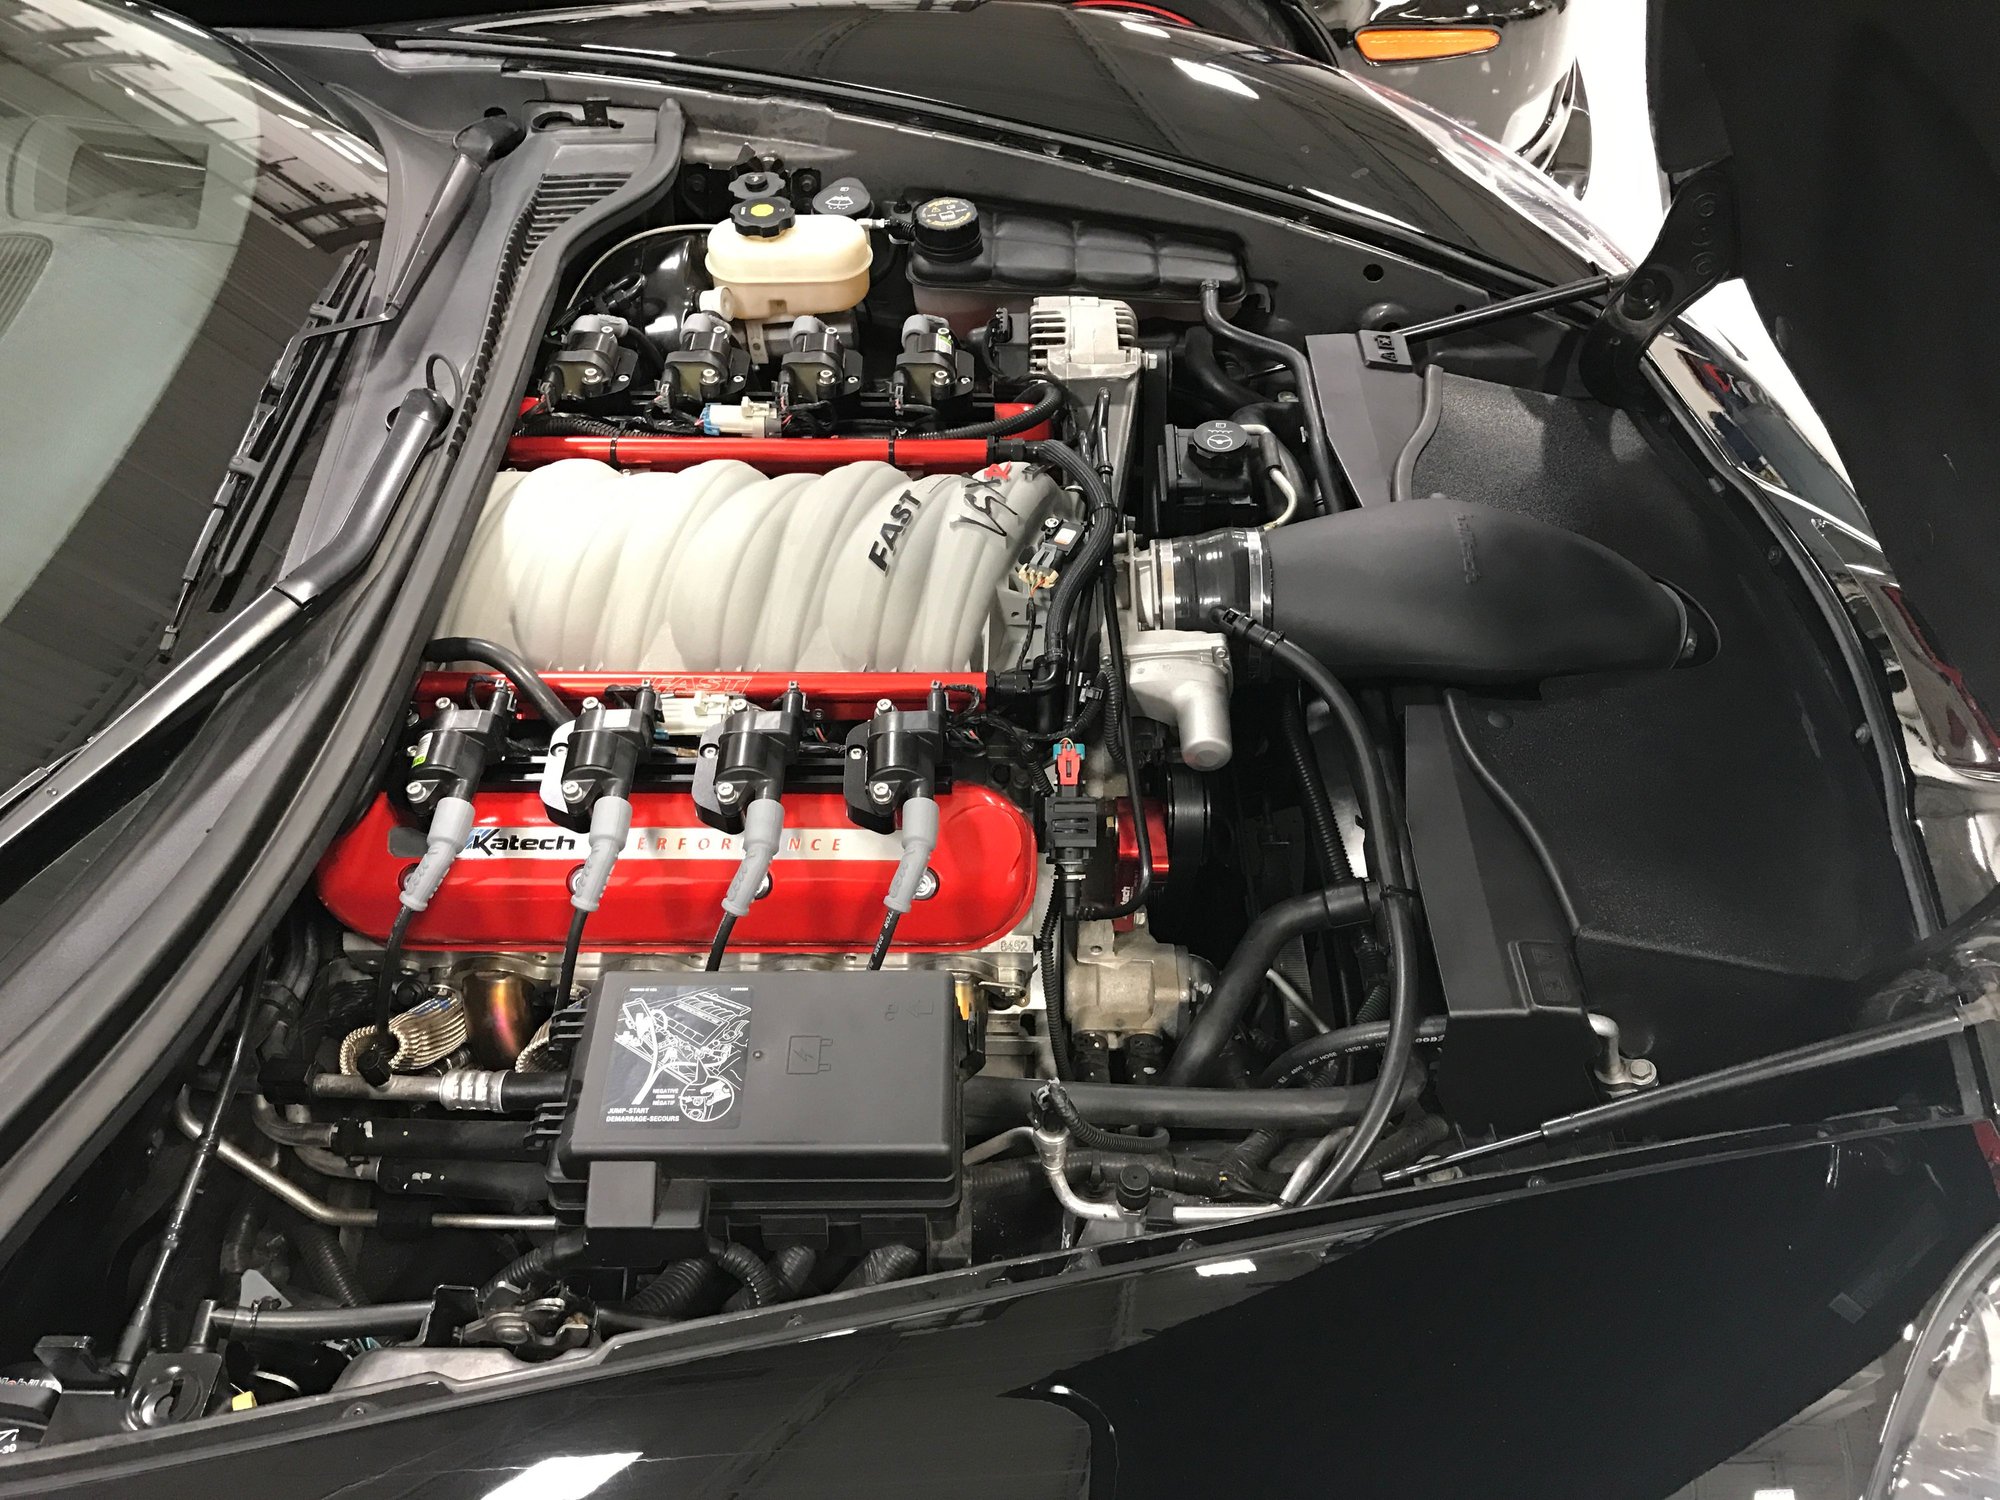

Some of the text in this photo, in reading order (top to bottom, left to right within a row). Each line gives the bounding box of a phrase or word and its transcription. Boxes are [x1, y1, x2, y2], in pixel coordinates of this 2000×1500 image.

[868, 489, 921, 573] FAST
[652, 676, 752, 694] FAST
[472, 828, 842, 856] Katech ERFORNCE
